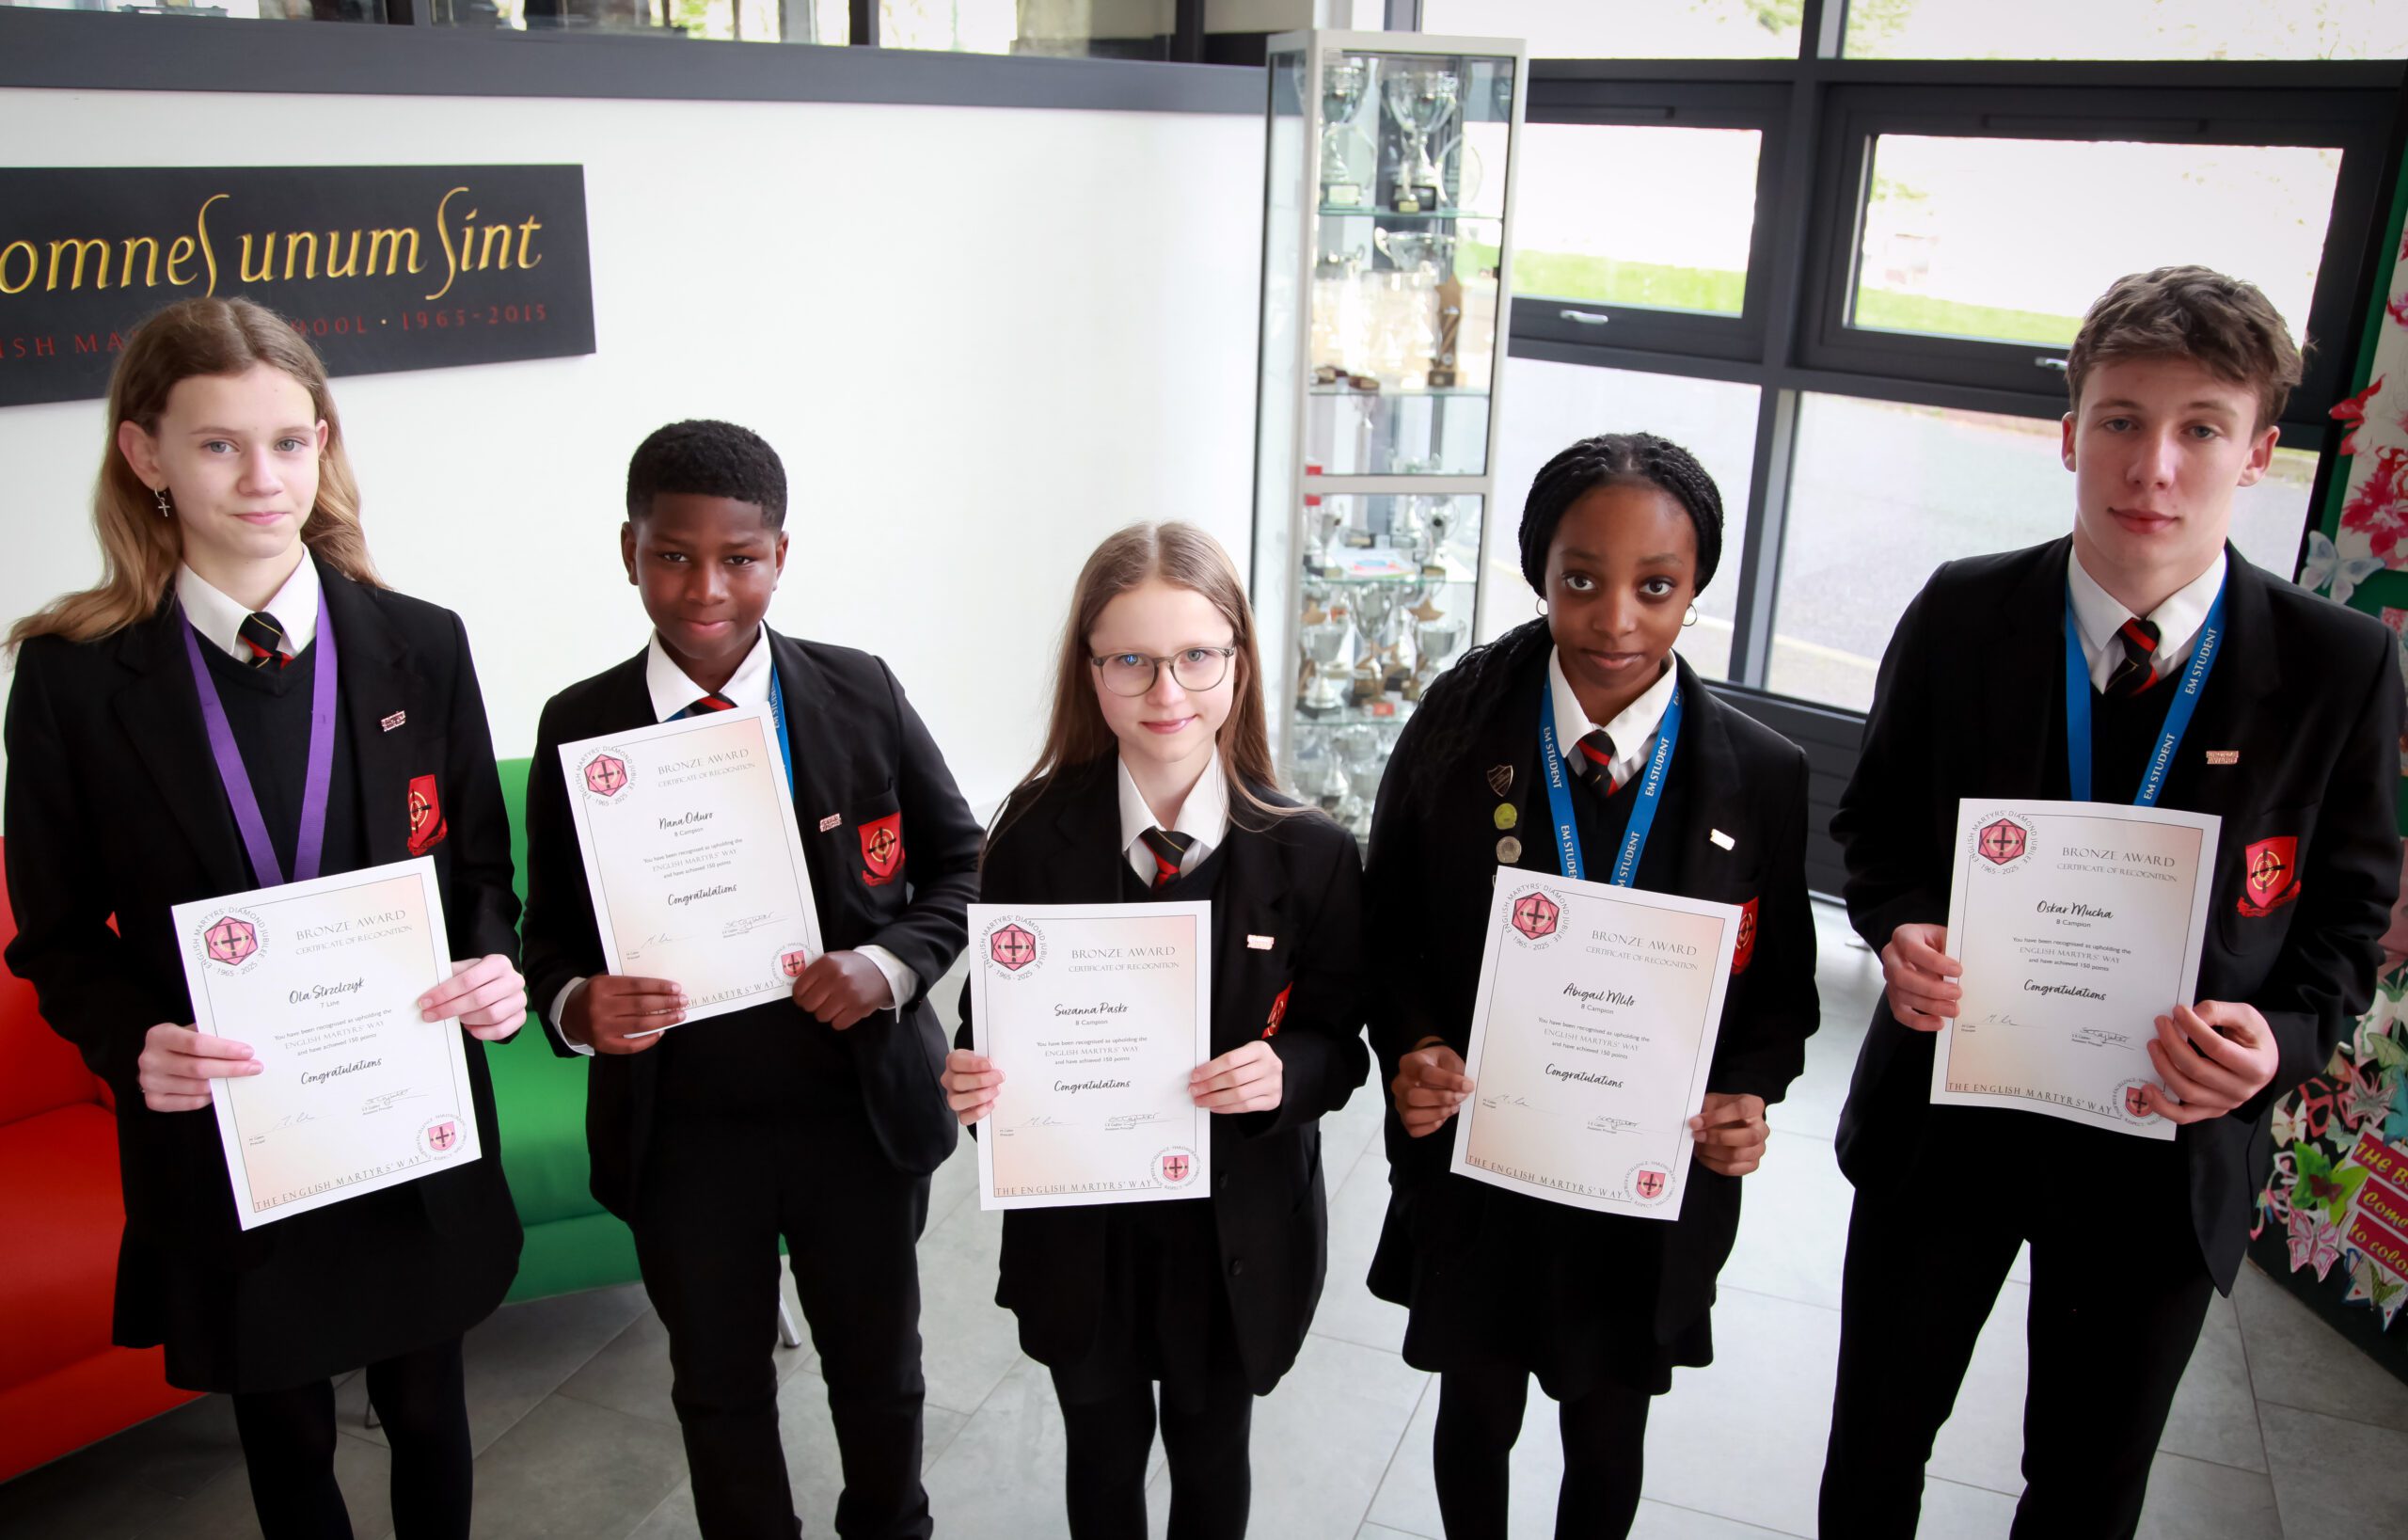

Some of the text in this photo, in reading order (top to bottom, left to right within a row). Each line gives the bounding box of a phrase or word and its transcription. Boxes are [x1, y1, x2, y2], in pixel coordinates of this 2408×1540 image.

[236, 227, 427, 283] unum
[2185, 627, 2218, 695] EM STUDENT
[1544, 726, 1561, 788] EM STUDENT
[1645, 737, 1670, 797] EM STUDENT
[2143, 733, 2176, 801] EM STUDENT
[1561, 825, 1577, 881] EM STUDEN
[1620, 831, 1640, 878] STUDENT
[2062, 847, 2175, 866] BRONZE AWARD
[2056, 863, 2105, 873] CERTIFICATE
[2119, 868, 2178, 881] RECOGNITION
[295, 910, 405, 940] BRONZE AWARD
[1071, 945, 1175, 959] BRONZE AWARD
[1592, 929, 1696, 955] BRONZE AWARD
[1126, 961, 1179, 970] RECOGNITION
[1585, 945, 1631, 960] CERTIFICATE
[1644, 956, 1698, 971] RECOGNITION
[2023, 978, 2106, 1000] Congratulations
[300, 1057, 381, 1084] Congratulations
[1545, 1062, 1624, 1088] Congratulations
[1054, 1078, 1130, 1094] Congratulations
[1948, 1082, 1969, 1092] THE
[1973, 1083, 2020, 1097] ENGLISH
[2086, 1101, 2111, 1114] WAY
[996, 1186, 1015, 1196] THE
[1021, 1183, 1065, 1194] ENGLISH
[1128, 1179, 1150, 1188] WAY
[1468, 1155, 1624, 1199] THE ENGLISH MARTYRS' WAY
[2349, 1224, 2408, 1275] to colo
